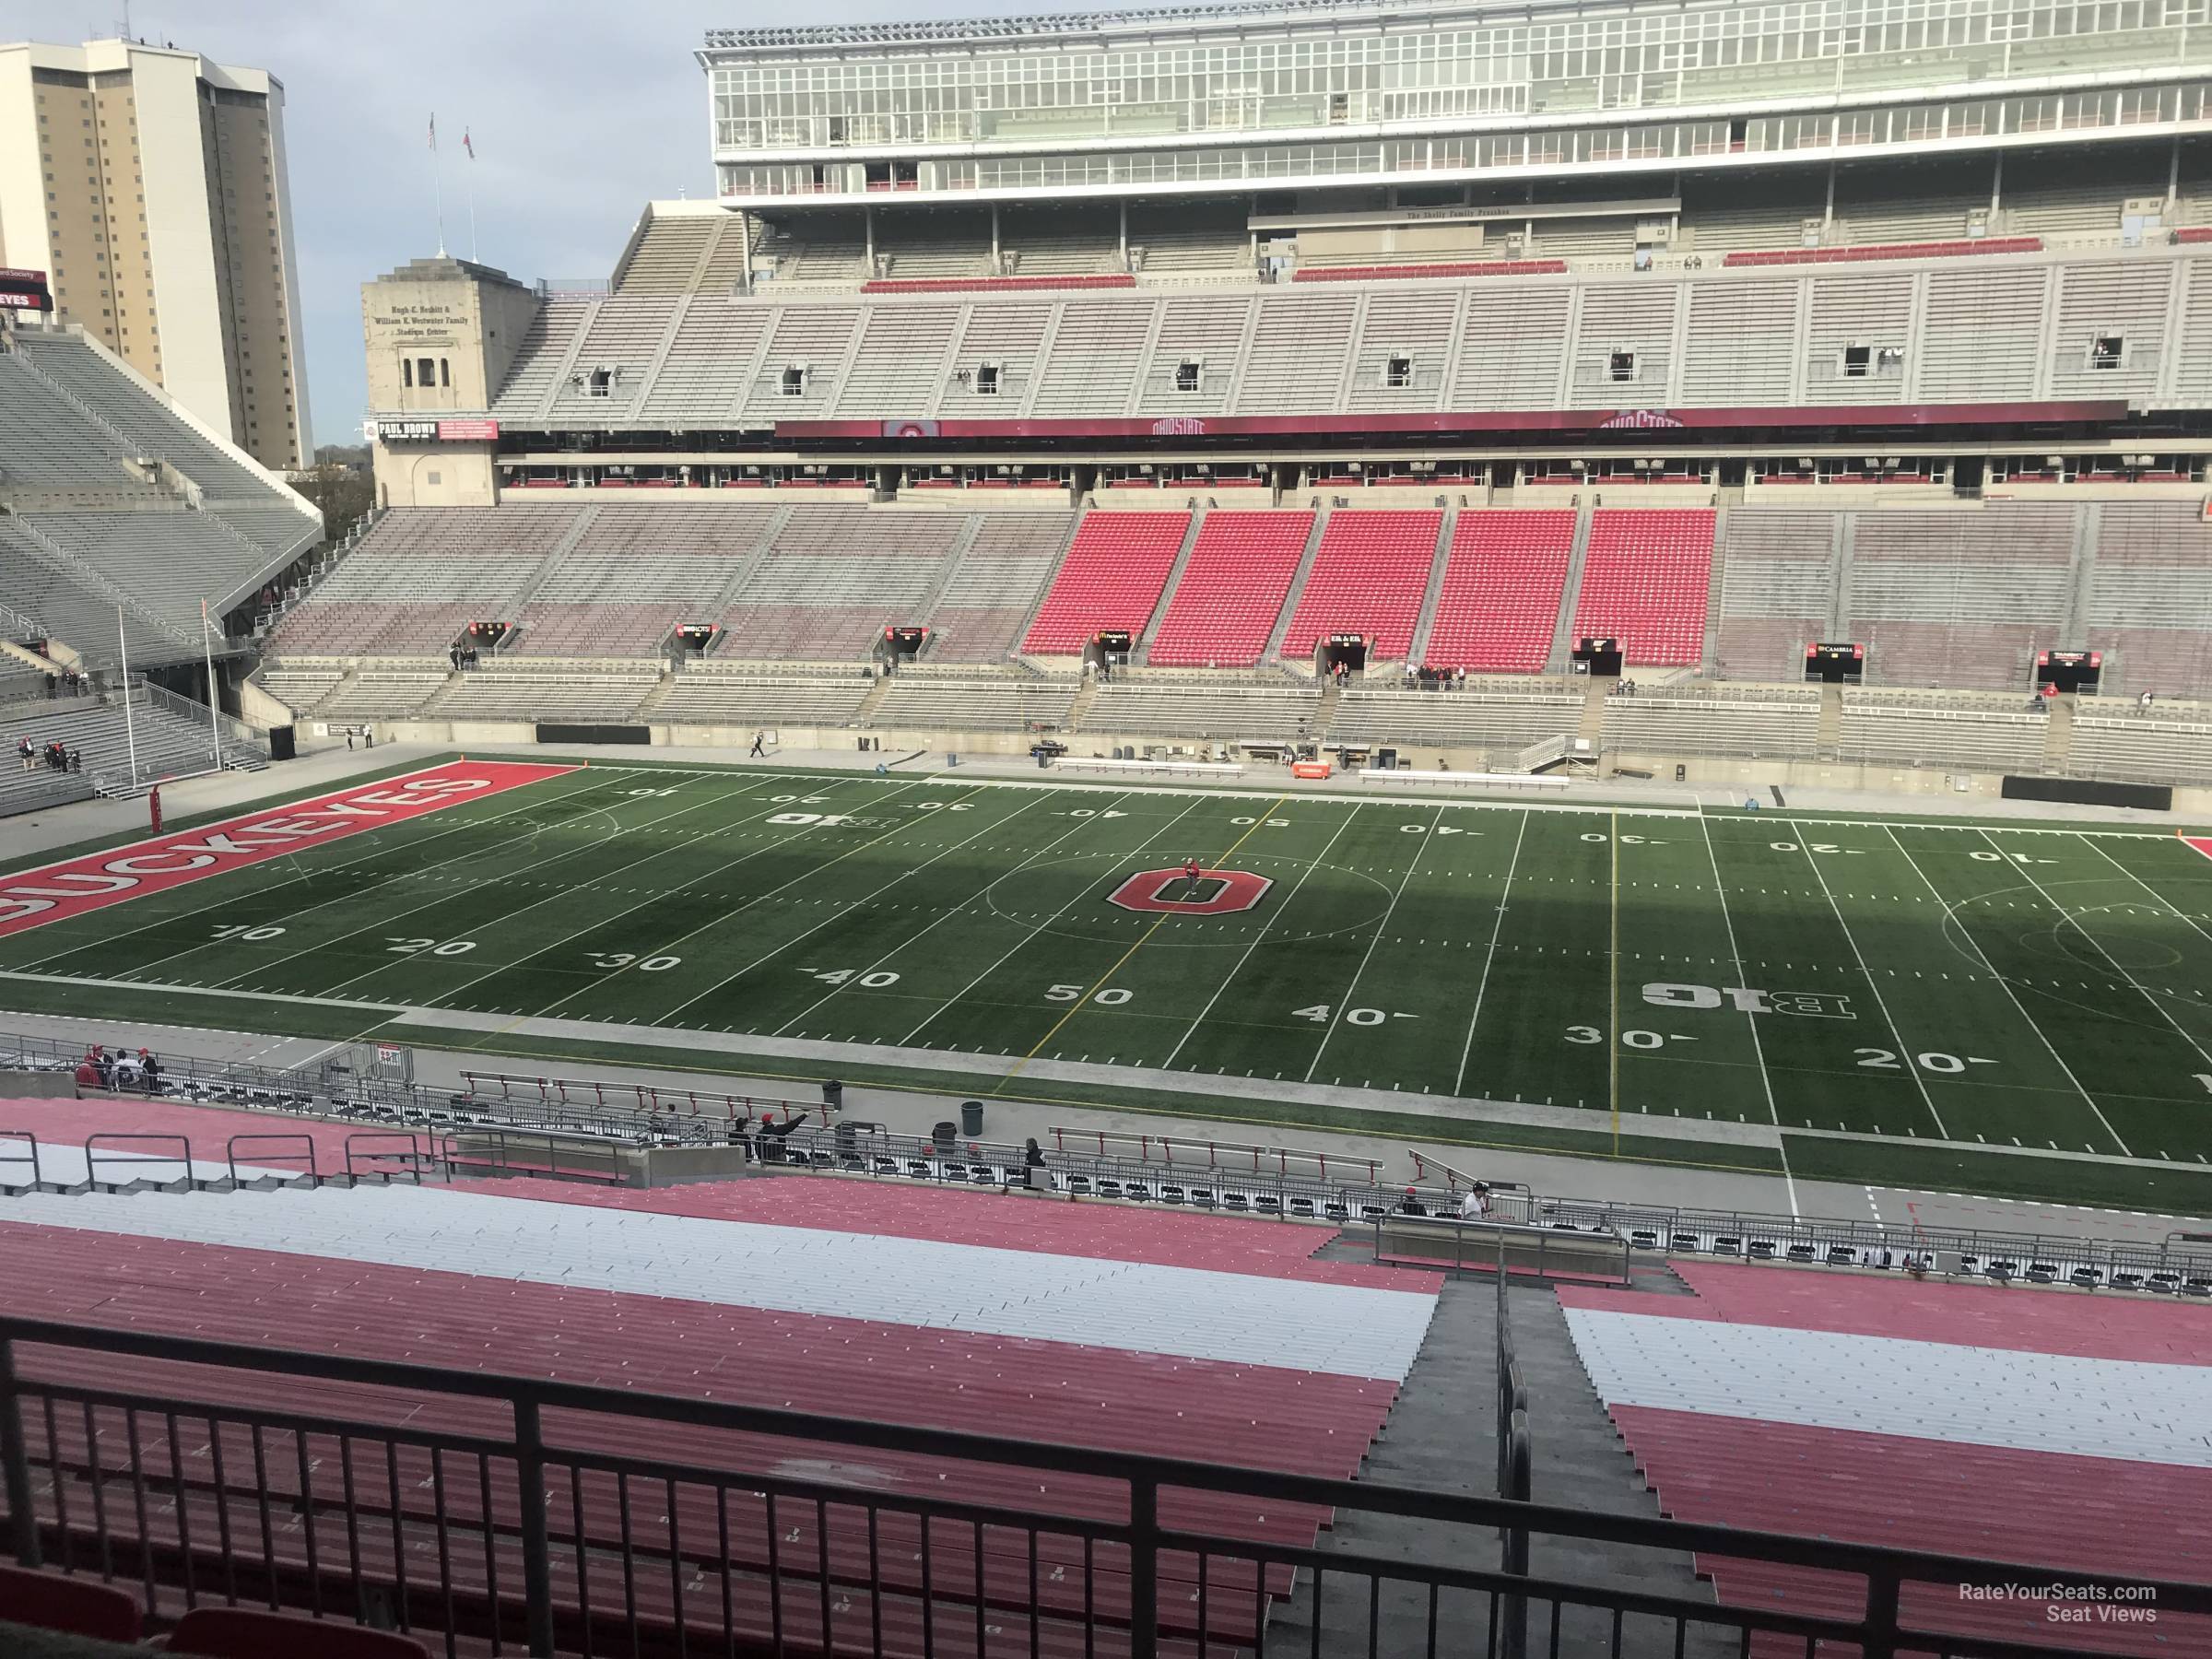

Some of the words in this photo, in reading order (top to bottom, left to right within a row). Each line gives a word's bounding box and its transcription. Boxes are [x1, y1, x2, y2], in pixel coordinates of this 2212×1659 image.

[379, 423, 402, 434] PAUL
[404, 423, 436, 434] BROWN
[385, 938, 477, 956] 20
[594, 953, 682, 971] 30
[813, 969, 900, 988] 40
[1043, 984, 1134, 1005] 50
[1290, 1005, 1386, 1026] 40
[1564, 1025, 1664, 1049] 30
[1853, 1048, 1966, 1073] 20
